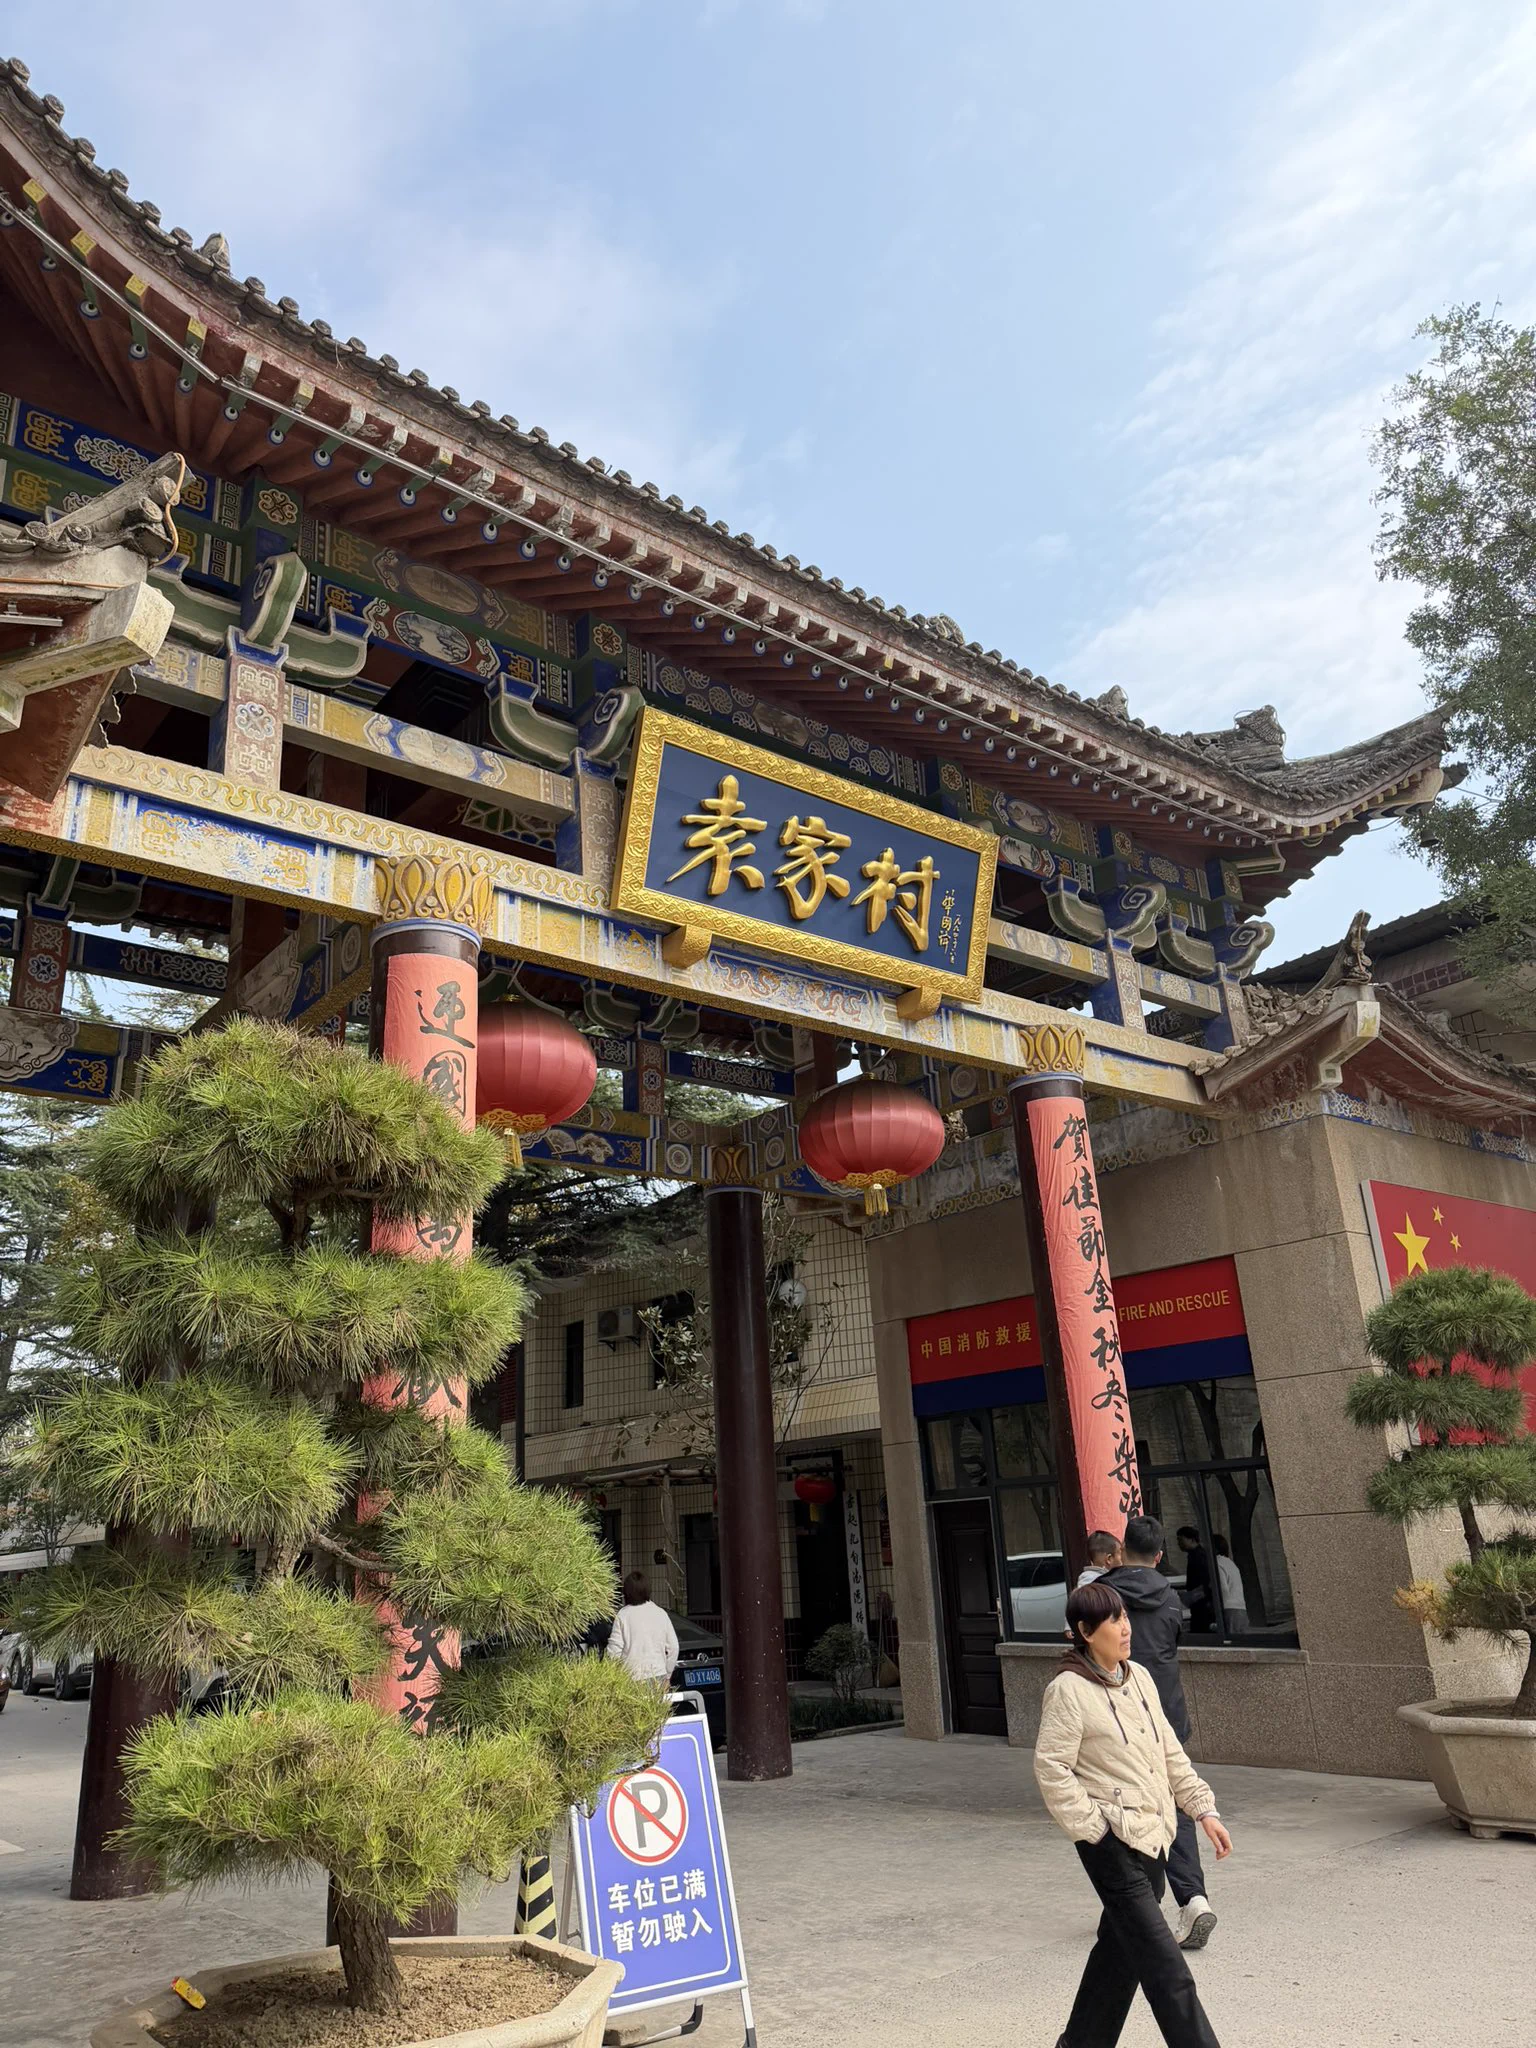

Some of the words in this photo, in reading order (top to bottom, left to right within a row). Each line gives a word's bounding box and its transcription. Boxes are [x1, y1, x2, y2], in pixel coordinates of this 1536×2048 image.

[665, 774, 941, 951] 袁家村
[1119, 1304, 1146, 1322] FIRE
[1149, 1299, 1174, 1317] AND
[1177, 1289, 1231, 1312] RESCUE
[921, 1321, 1032, 1360] 中国消防救援
[607, 1868, 707, 1914] 车位已满
[611, 1907, 713, 1954] 暂勿驶入
